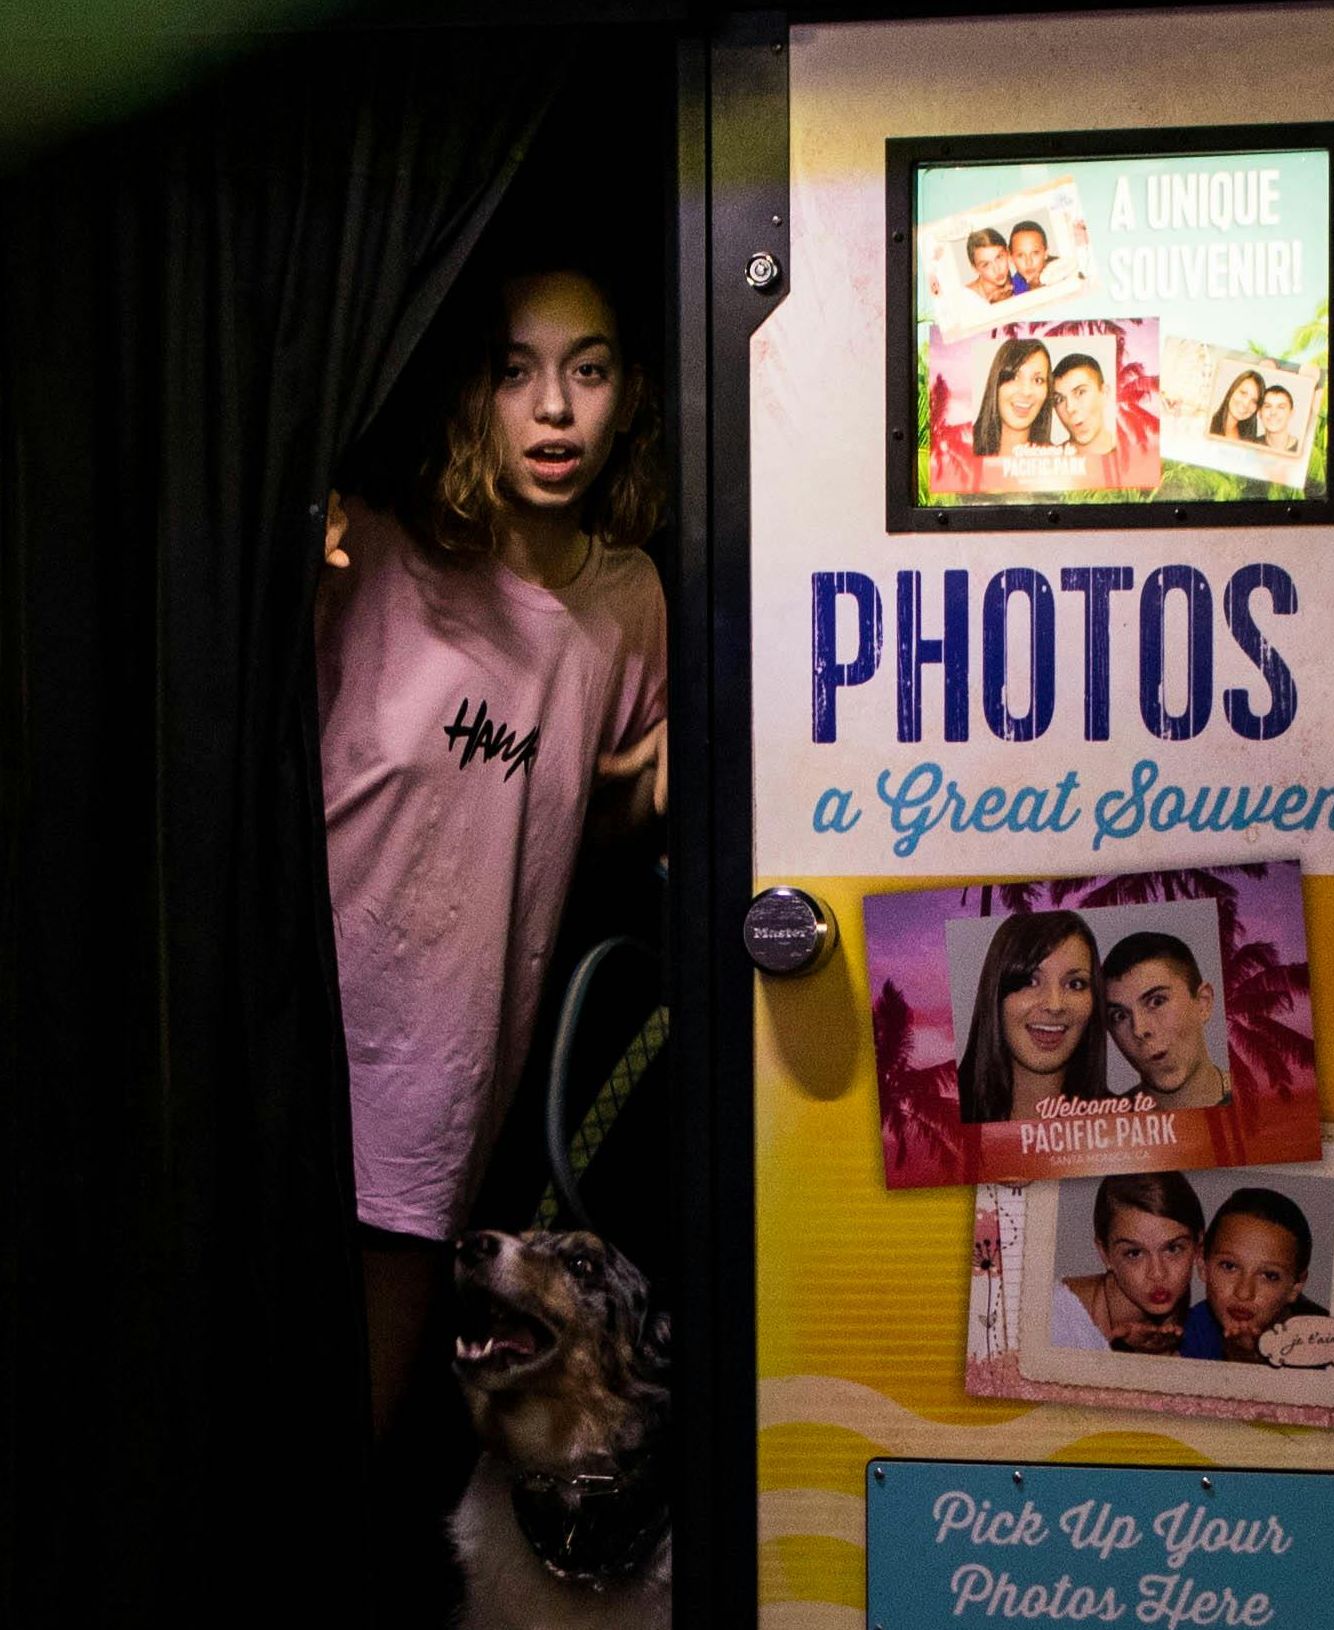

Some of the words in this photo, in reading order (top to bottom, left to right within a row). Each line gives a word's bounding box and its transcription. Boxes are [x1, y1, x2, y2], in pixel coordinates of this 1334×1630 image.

[1110, 175, 1136, 232] A
[1147, 170, 1281, 232] UNIQUE
[1108, 239, 1304, 302] SOUVENIR!
[812, 563, 1300, 743] PHOTOS
[812, 786, 862, 834] a
[875, 761, 1080, 858] Great
[1019, 1118, 1109, 1154] PACIFIC
[1116, 1113, 1178, 1148] PARK
[1035, 1093, 1131, 1120] Welcome
[1133, 1091, 1157, 1112] to
[932, 1490, 1049, 1546] Pick
[1058, 1498, 1144, 1559] Up
[1153, 1500, 1292, 1569] Your
[949, 1563, 1127, 1622] Photos
[1136, 1573, 1275, 1630] Here
